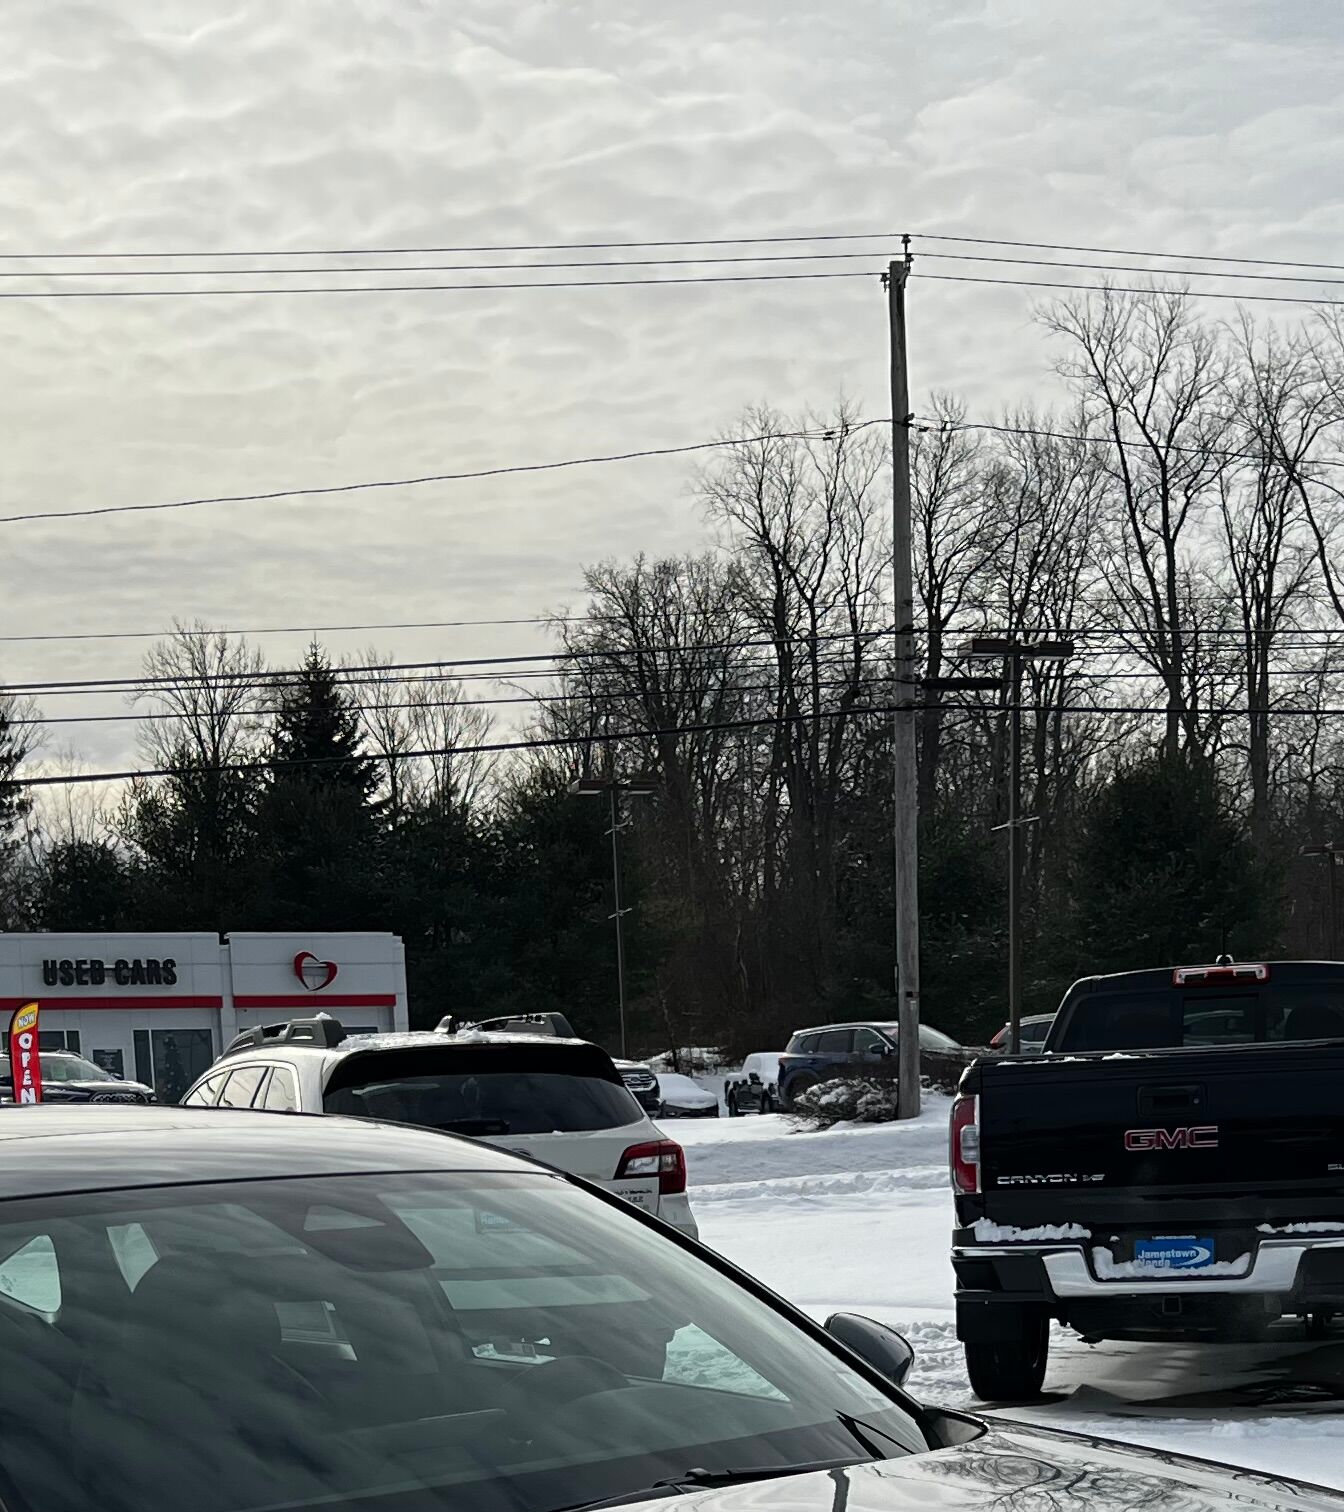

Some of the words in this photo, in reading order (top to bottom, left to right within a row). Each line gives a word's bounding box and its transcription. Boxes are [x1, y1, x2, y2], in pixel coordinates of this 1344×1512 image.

[43, 959, 105, 986] USED
[115, 958, 177, 986] CARS
[1124, 1125, 1218, 1151] GMC
[997, 1174, 1077, 1185] CANYON
[1138, 1249, 1197, 1259] Jamestown
